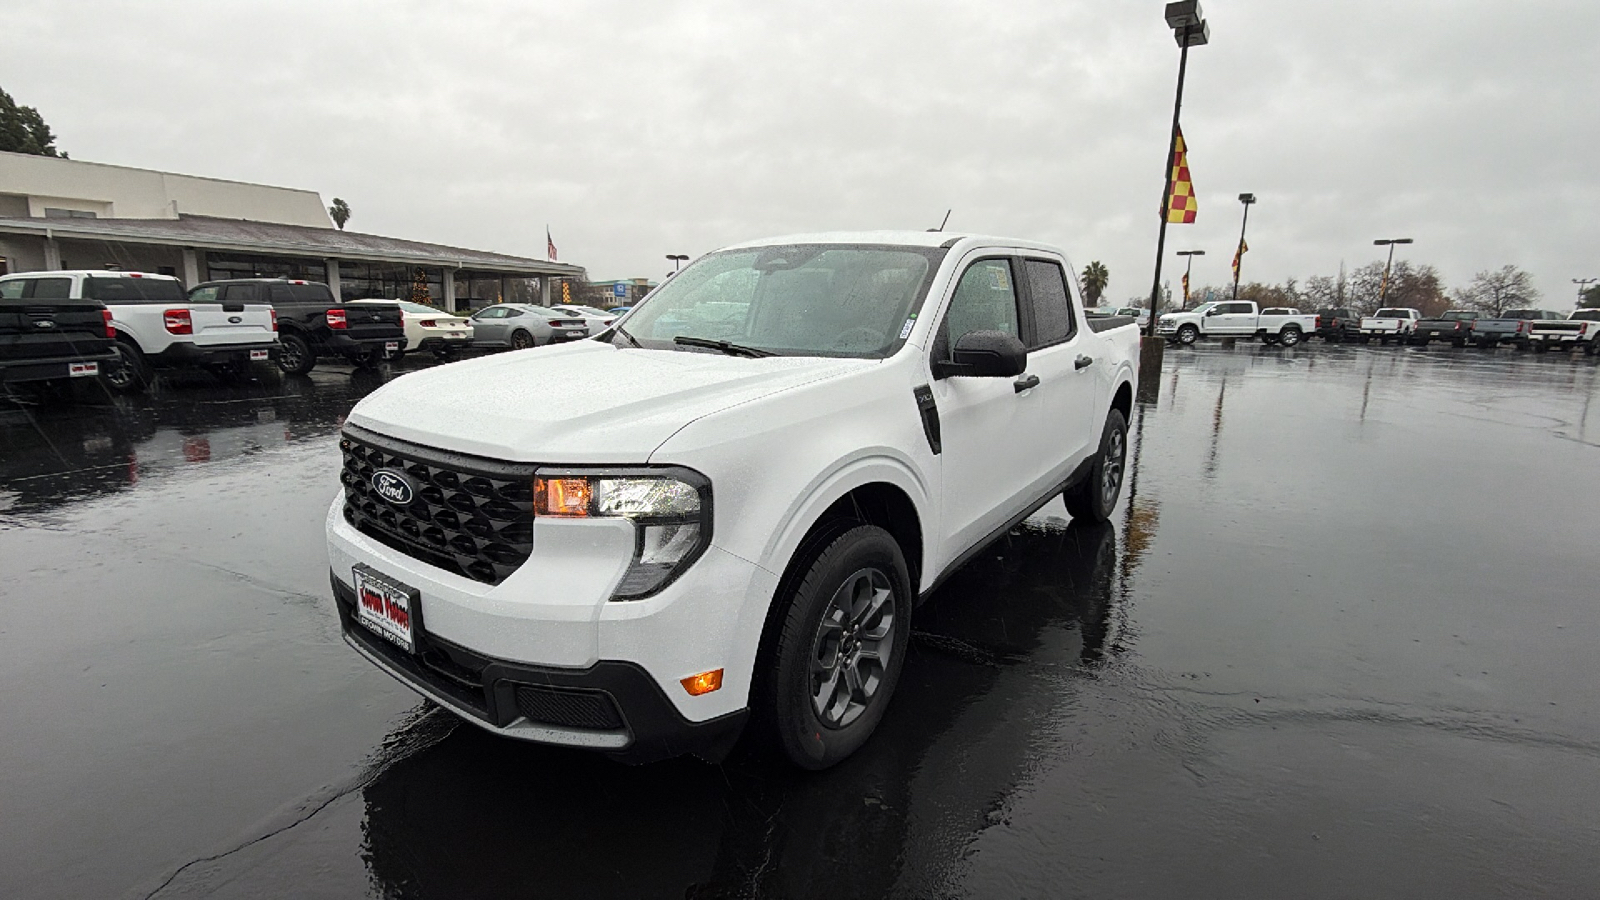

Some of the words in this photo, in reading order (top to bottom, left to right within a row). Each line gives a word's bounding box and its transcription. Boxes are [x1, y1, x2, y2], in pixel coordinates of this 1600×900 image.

[379, 475, 403, 500] Ford
[361, 616, 382, 634] CROWN
[384, 630, 409, 651] MOTORS
